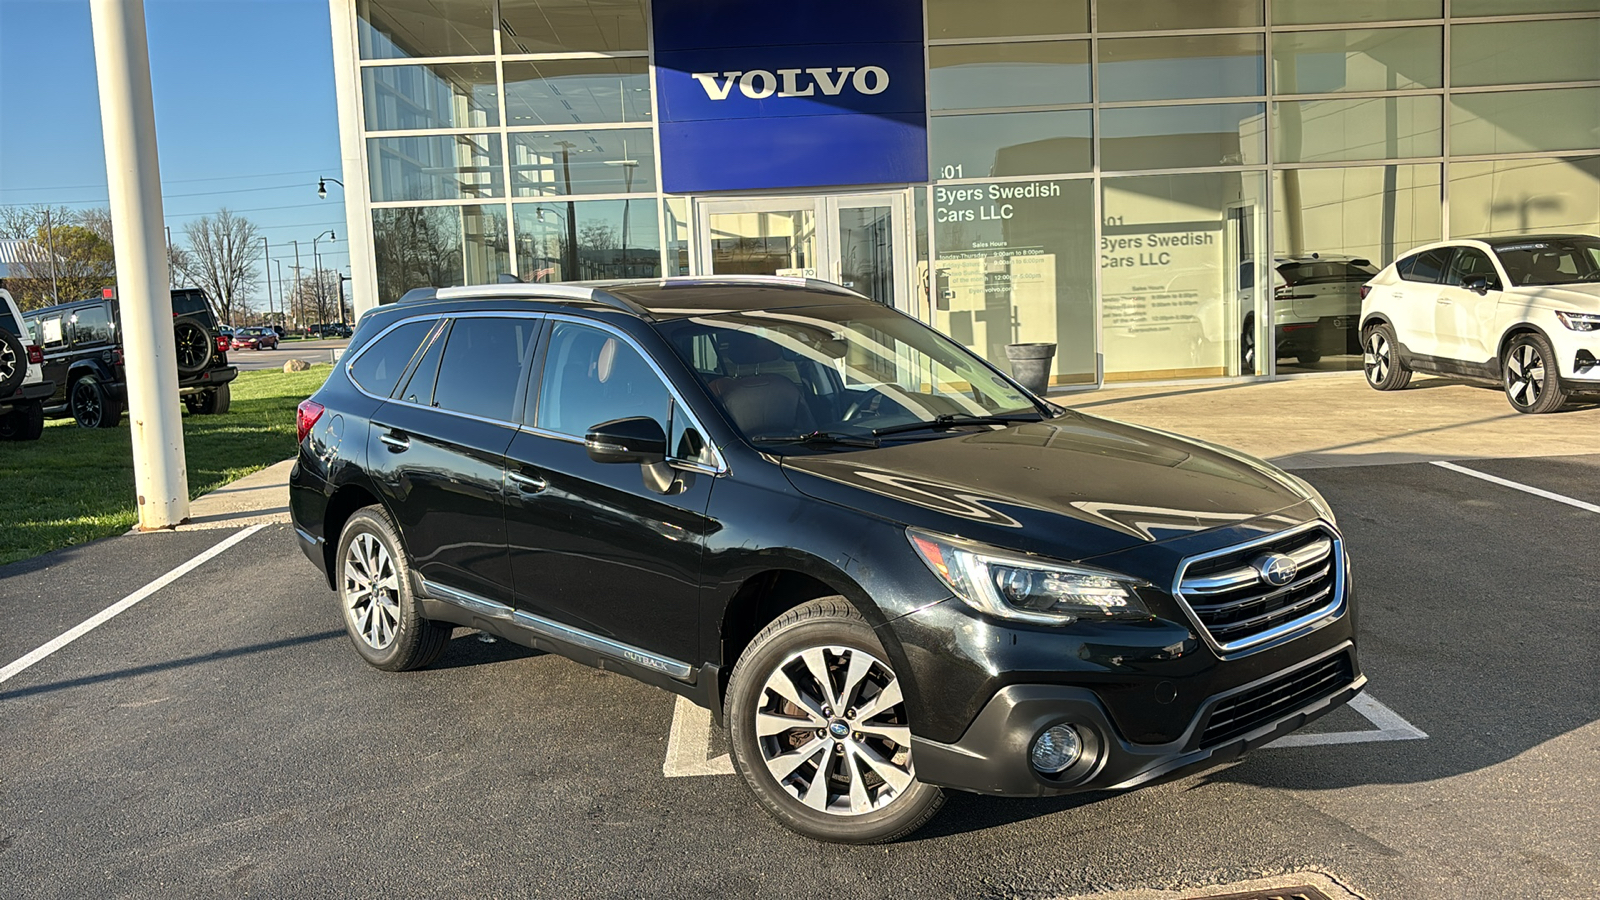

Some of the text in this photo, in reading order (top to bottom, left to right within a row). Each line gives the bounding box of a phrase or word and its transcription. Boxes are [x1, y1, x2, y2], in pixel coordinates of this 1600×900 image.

[691, 65, 890, 101] VOLVO
[937, 182, 1060, 206] Byers Swedish
[937, 204, 1014, 223] Cars LLC
[1147, 232, 1213, 248] Swedish
[1139, 252, 1171, 266] LLC
[624, 650, 668, 671] OUTBACK
